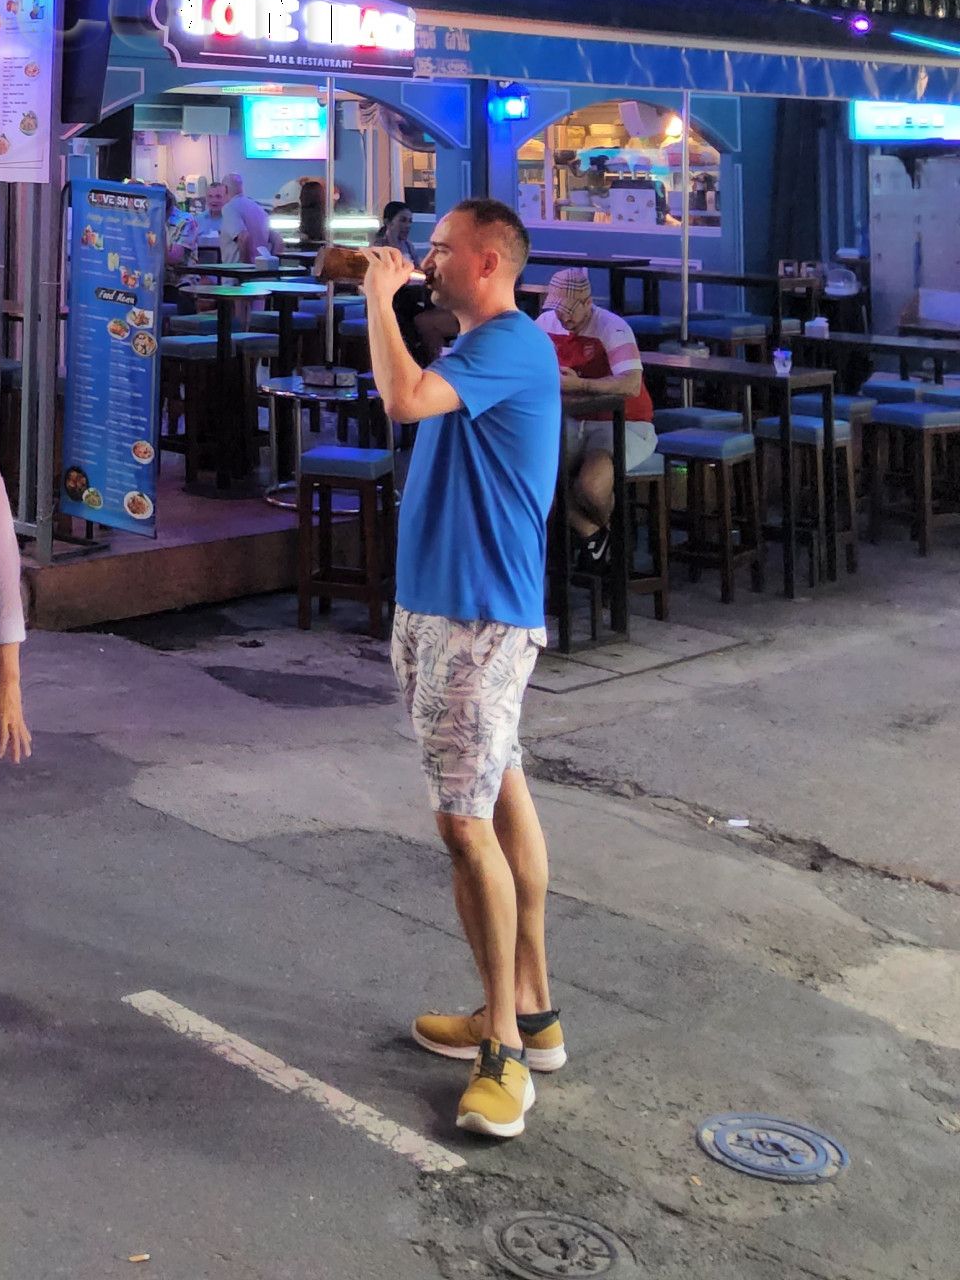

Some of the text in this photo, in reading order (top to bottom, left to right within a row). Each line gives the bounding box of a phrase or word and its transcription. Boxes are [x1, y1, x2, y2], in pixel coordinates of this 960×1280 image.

[269, 54, 353, 69] BAR & RESTAURANT
[91, 193, 146, 209] LOVE SHACK
[99, 289, 116, 301] Food
